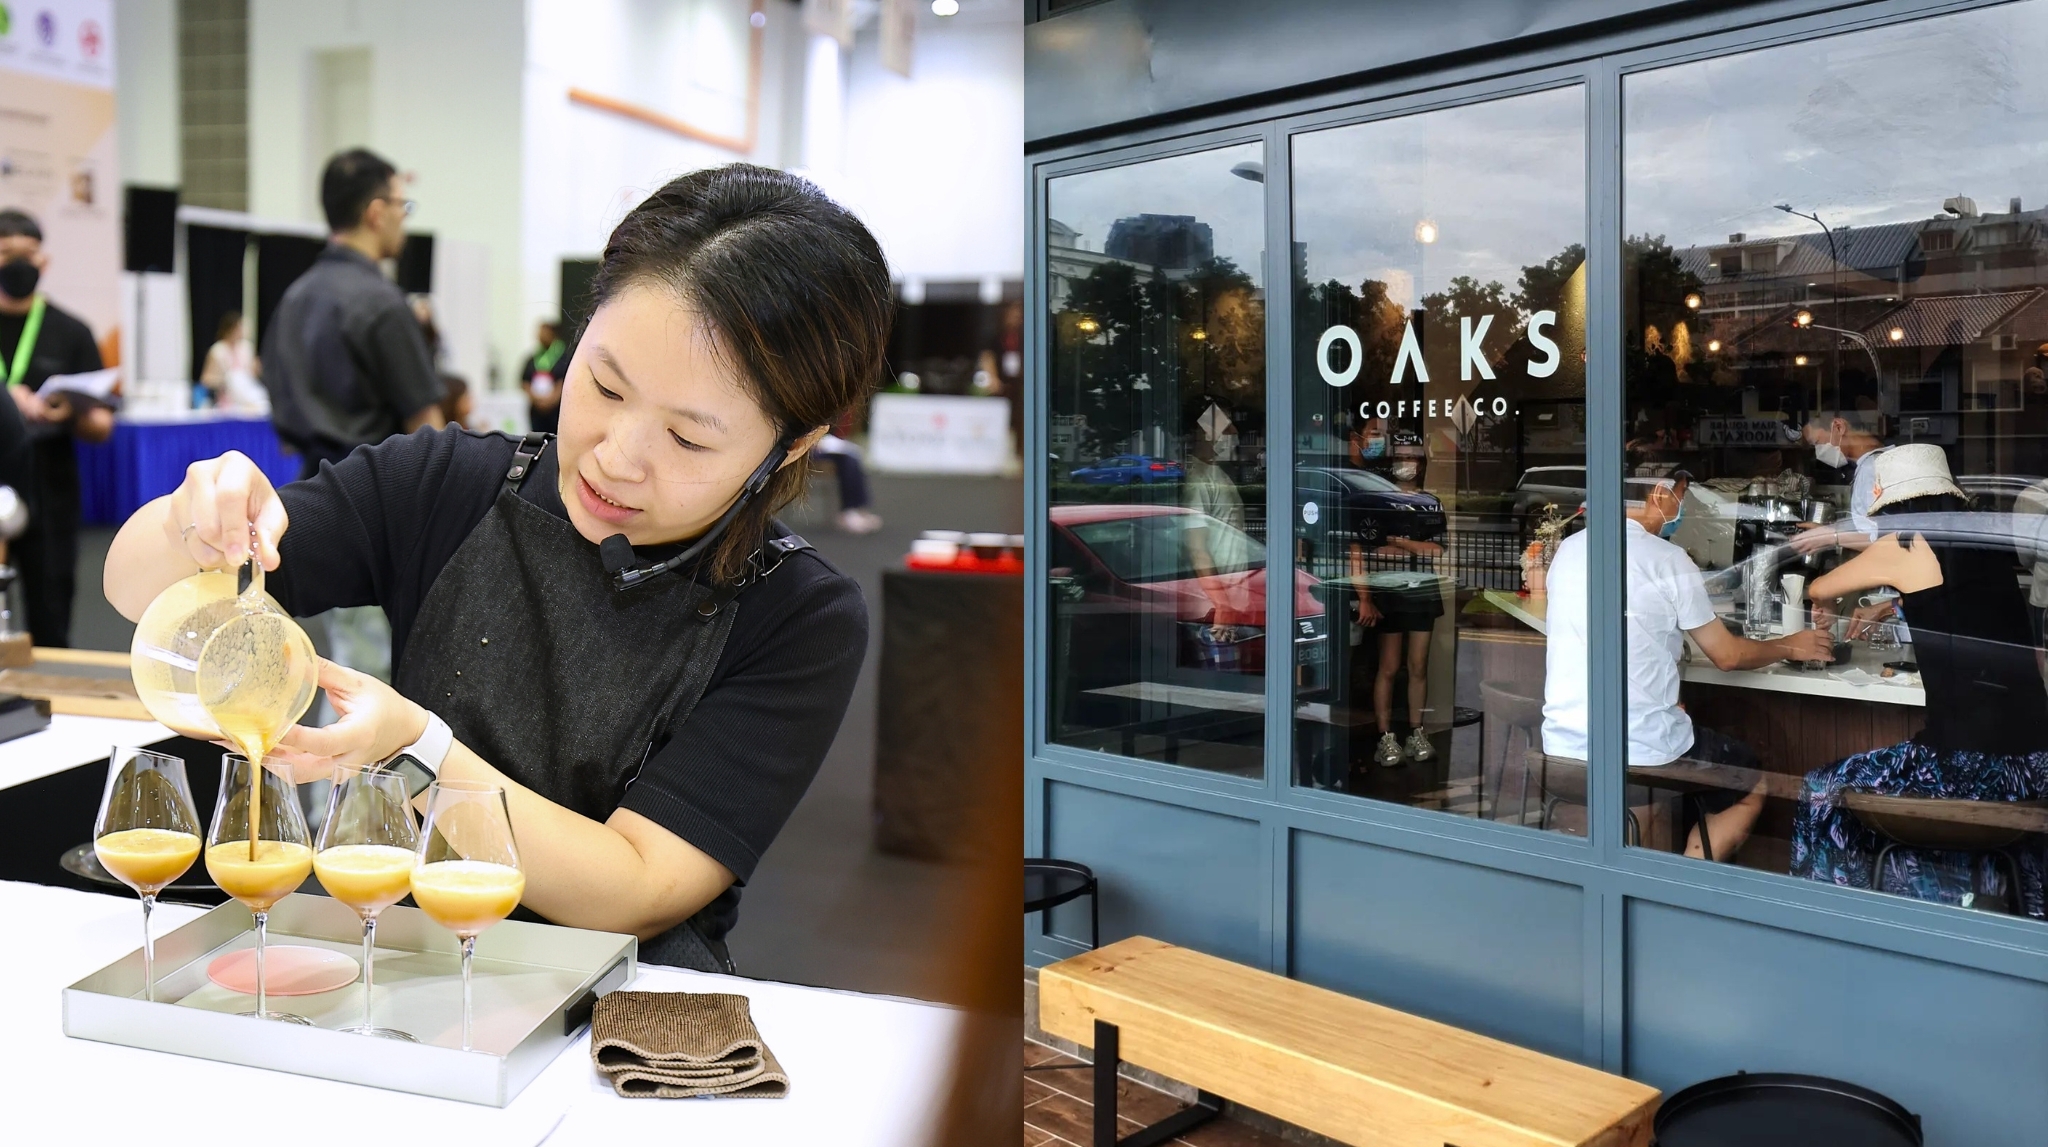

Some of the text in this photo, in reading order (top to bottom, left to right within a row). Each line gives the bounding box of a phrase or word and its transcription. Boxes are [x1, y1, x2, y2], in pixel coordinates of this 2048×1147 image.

[1317, 310, 1560, 387] OAKS
[1359, 397, 1520, 419] COFFEE CO.
